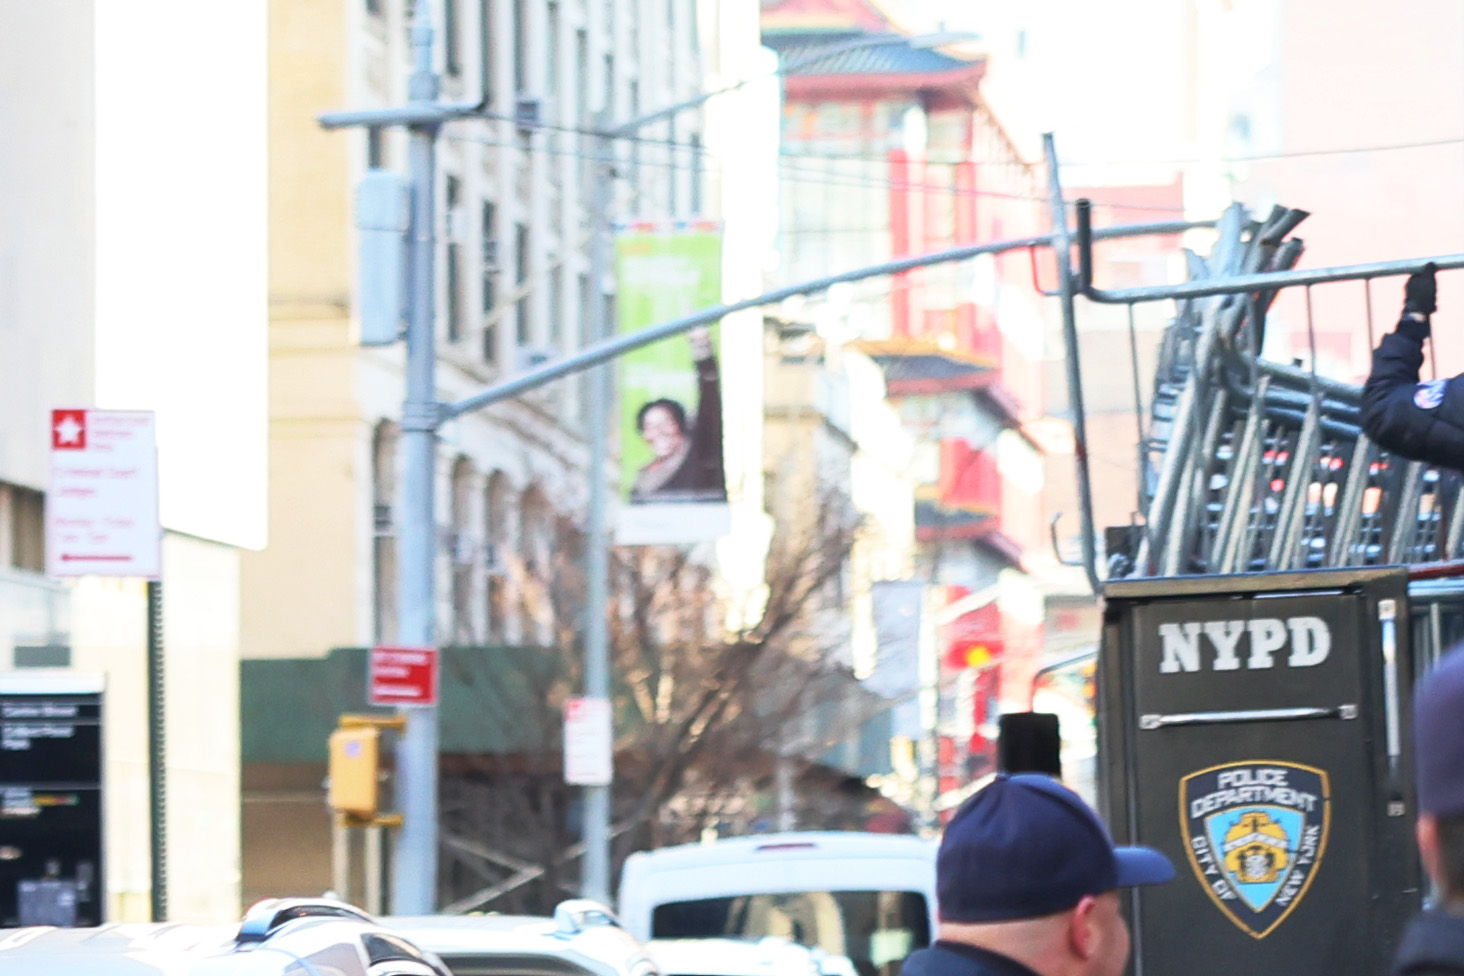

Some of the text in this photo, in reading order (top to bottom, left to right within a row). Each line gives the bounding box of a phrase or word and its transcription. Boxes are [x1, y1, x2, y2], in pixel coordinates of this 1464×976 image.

[1158, 616, 1332, 673] NYPD
[1217, 769, 1288, 789] POLICE
[1191, 786, 1318, 819] DEPARTMENT
[1191, 835, 1238, 901] CITY OF
